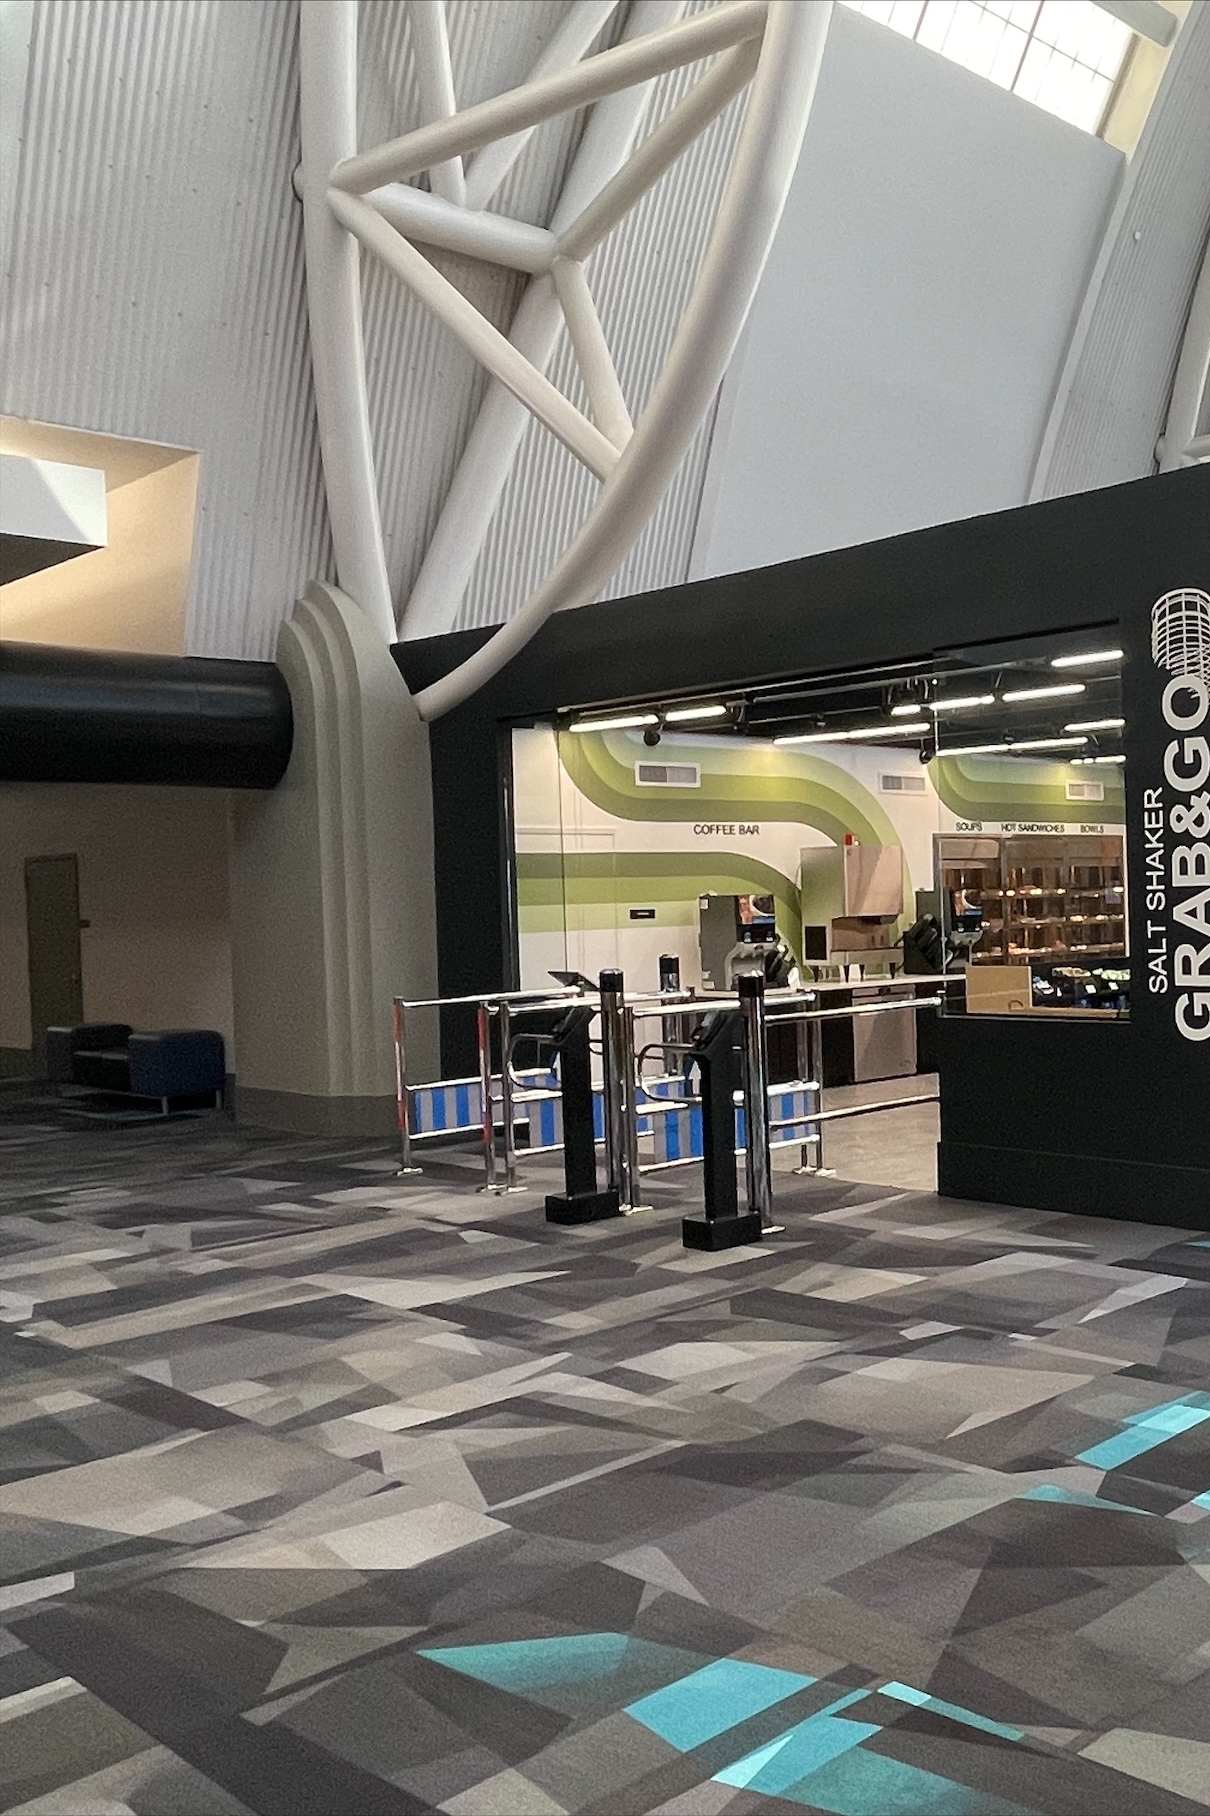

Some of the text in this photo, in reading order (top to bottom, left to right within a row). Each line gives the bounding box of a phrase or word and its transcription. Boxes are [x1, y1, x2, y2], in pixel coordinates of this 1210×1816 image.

[693, 824, 760, 835] COFFEE BAR
[956, 821, 983, 831] SOUPS
[1001, 823, 1065, 832] HOT SANDWICHES
[1080, 824, 1105, 834] BOWLS
[1143, 786, 1169, 994] SALT SHAKER
